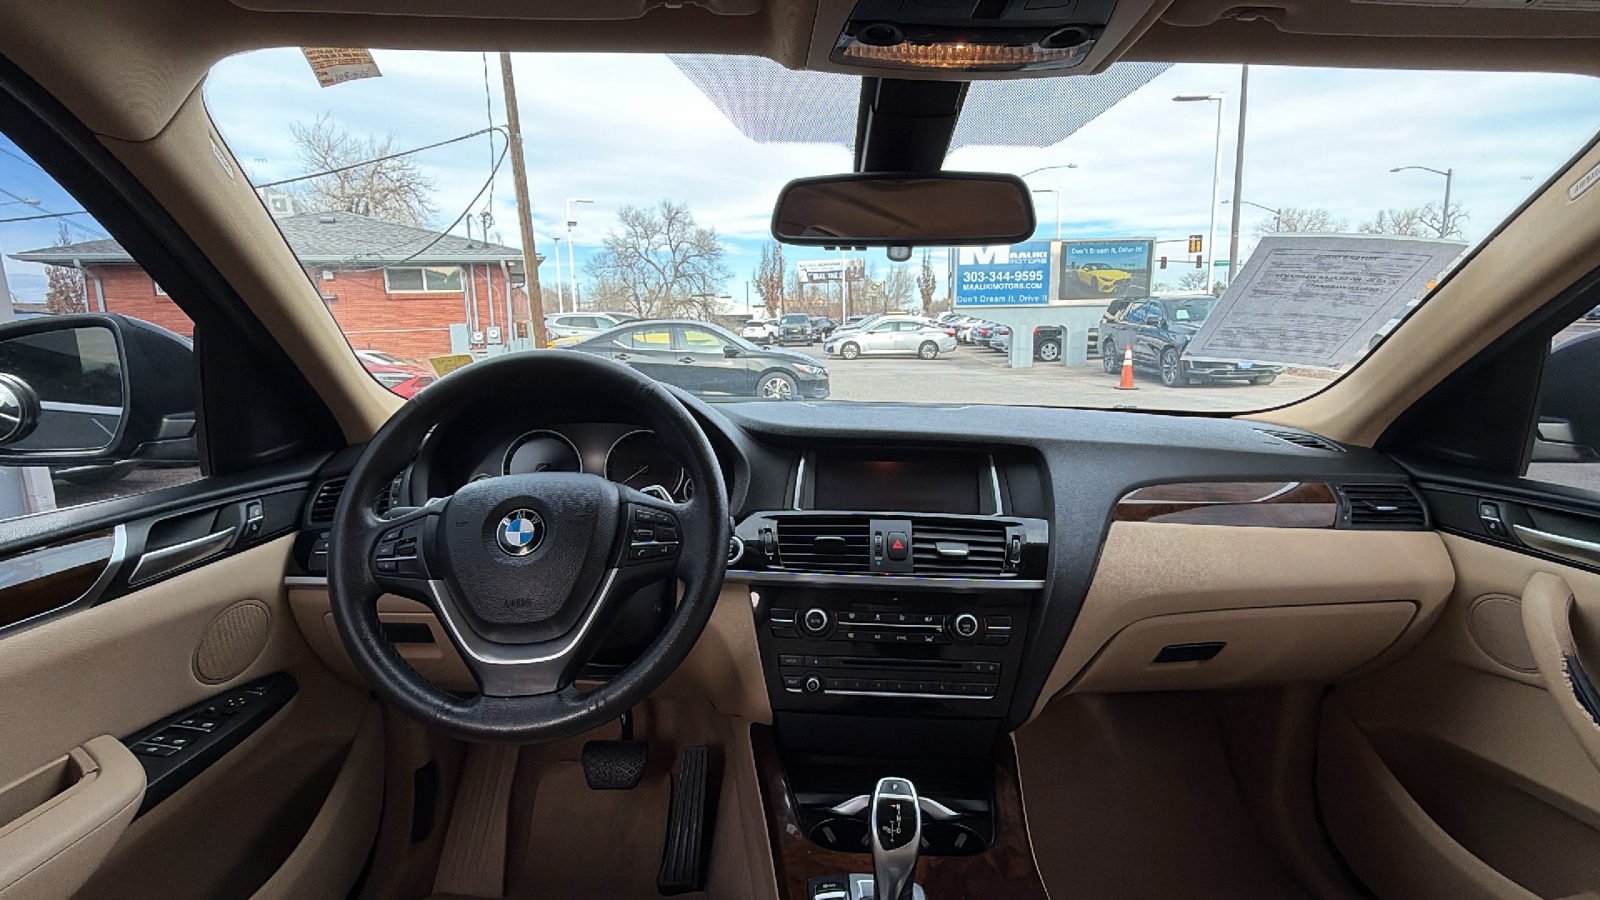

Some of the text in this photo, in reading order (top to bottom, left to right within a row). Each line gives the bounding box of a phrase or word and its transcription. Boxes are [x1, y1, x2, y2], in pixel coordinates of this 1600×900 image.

[962, 270, 1044, 283] 303-344-9595
[962, 283, 1043, 291] MAALIKIMOTORS.COM
[957, 295, 978, 303] Don't
[979, 294, 1006, 303] Dream
[1018, 294, 1040, 302] Drive
